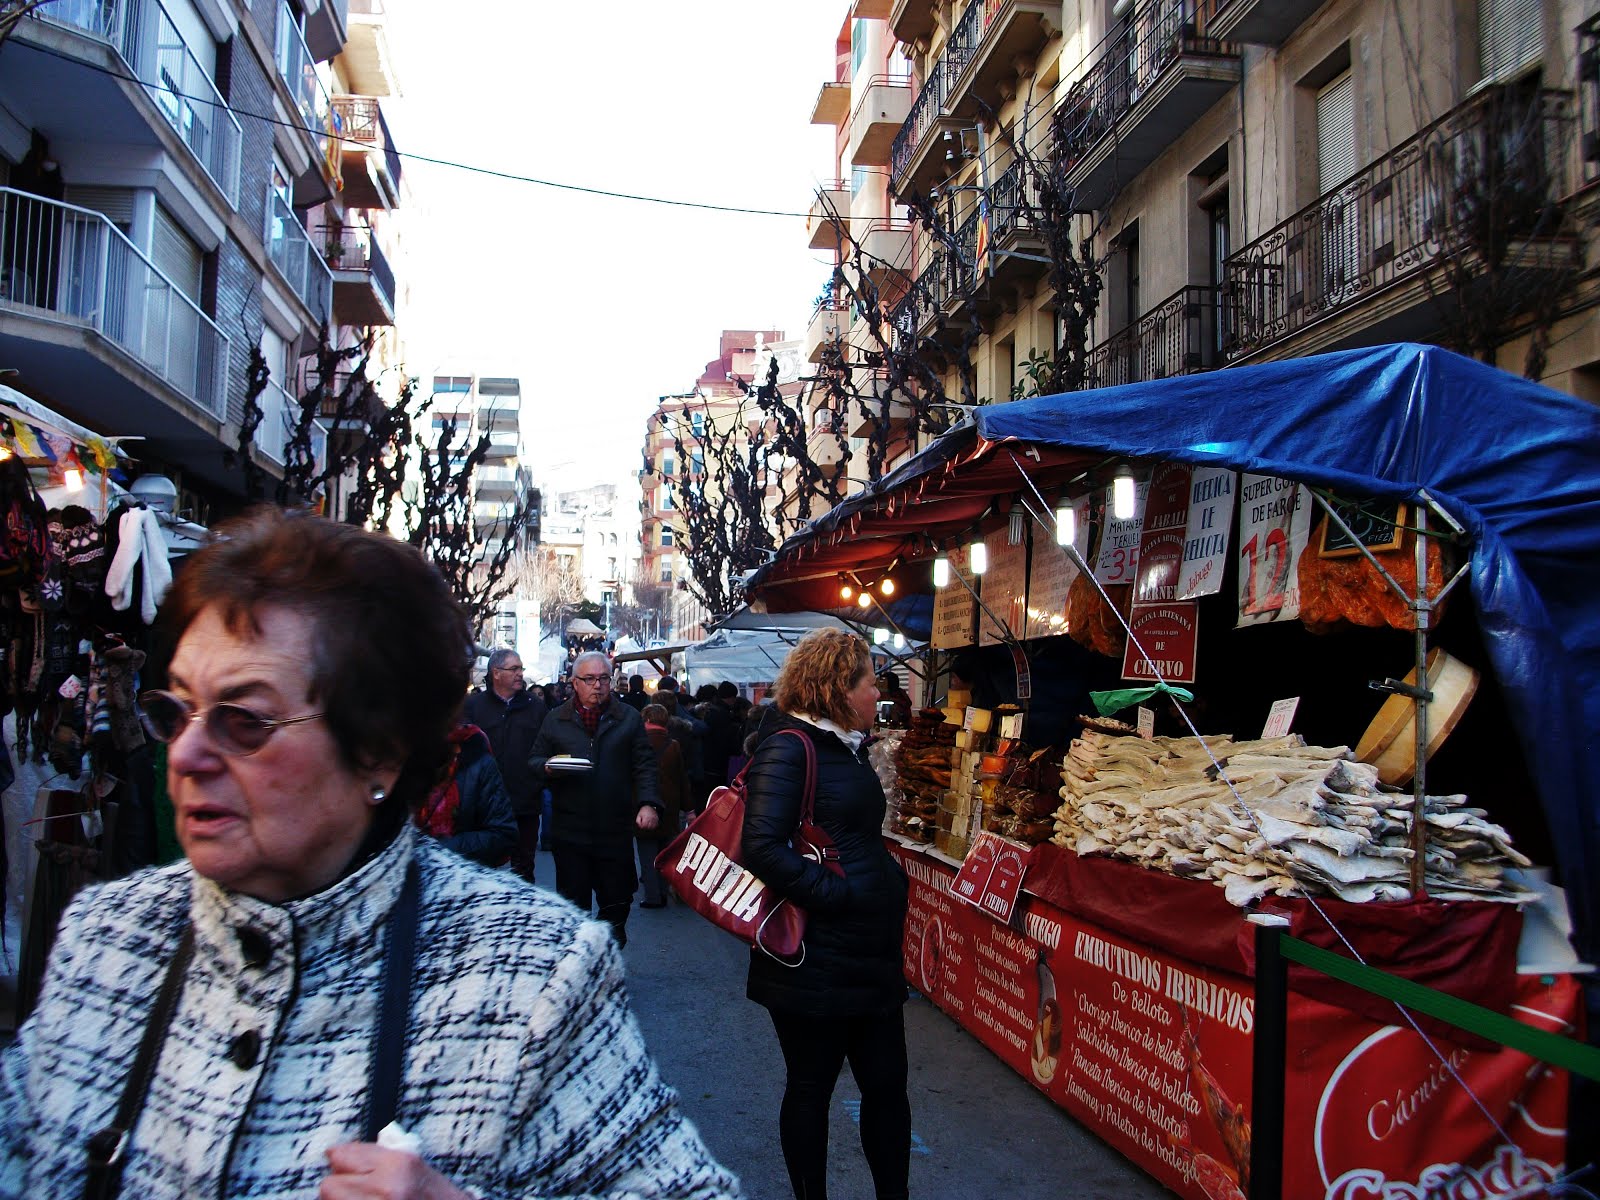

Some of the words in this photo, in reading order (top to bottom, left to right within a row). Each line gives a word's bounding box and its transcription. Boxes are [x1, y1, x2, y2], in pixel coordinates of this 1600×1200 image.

[1242, 478, 1272, 503] SUPER
[1252, 505, 1265, 524] DE
[1241, 528, 1287, 617] 12
[1133, 611, 1157, 630] CECINA
[1157, 609, 1192, 632] ARTESANA
[1133, 658, 1184, 677] CIERVO
[1155, 641, 1166, 651] DE
[675, 832, 766, 923] PUMA
[984, 891, 1009, 917] CIERVO
[1006, 931, 1017, 950] de
[1016, 938, 1038, 965] Oveja
[944, 965, 957, 984] Toro
[1074, 930, 1162, 992] EMBUTIDOS
[1164, 965, 1255, 1035] IBERICOS
[973, 1002, 994, 1028] Curado
[994, 1021, 1005, 1037] con
[1004, 1028, 1028, 1052] romero
[976, 980, 997, 1005] Curado
[996, 1000, 1008, 1014] con
[1007, 1005, 1035, 1031] manteca
[1112, 981, 1128, 1003] De
[1131, 989, 1173, 1026] Bellota
[1078, 993, 1111, 1031] Chorizo
[1110, 1009, 1142, 1043] Iberico
[1141, 1027, 1155, 1052] de
[1154, 1032, 1187, 1072] bellota
[1072, 1047, 1103, 1083] Panceta
[1101, 1068, 1133, 1105] Iberica
[1132, 1088, 1147, 1115] de
[1146, 1096, 1185, 1139] bellota
[1118, 1046, 1149, 1082] Iberico
[1148, 1065, 1162, 1092] de
[1161, 1072, 1202, 1115] bellota
[1064, 1073, 1100, 1115] Jamones
[1099, 1103, 1106, 1122] y
[1106, 1103, 1142, 1145] Paletas
[1141, 1126, 1156, 1152] de
[1155, 1134, 1200, 1184] bodega
